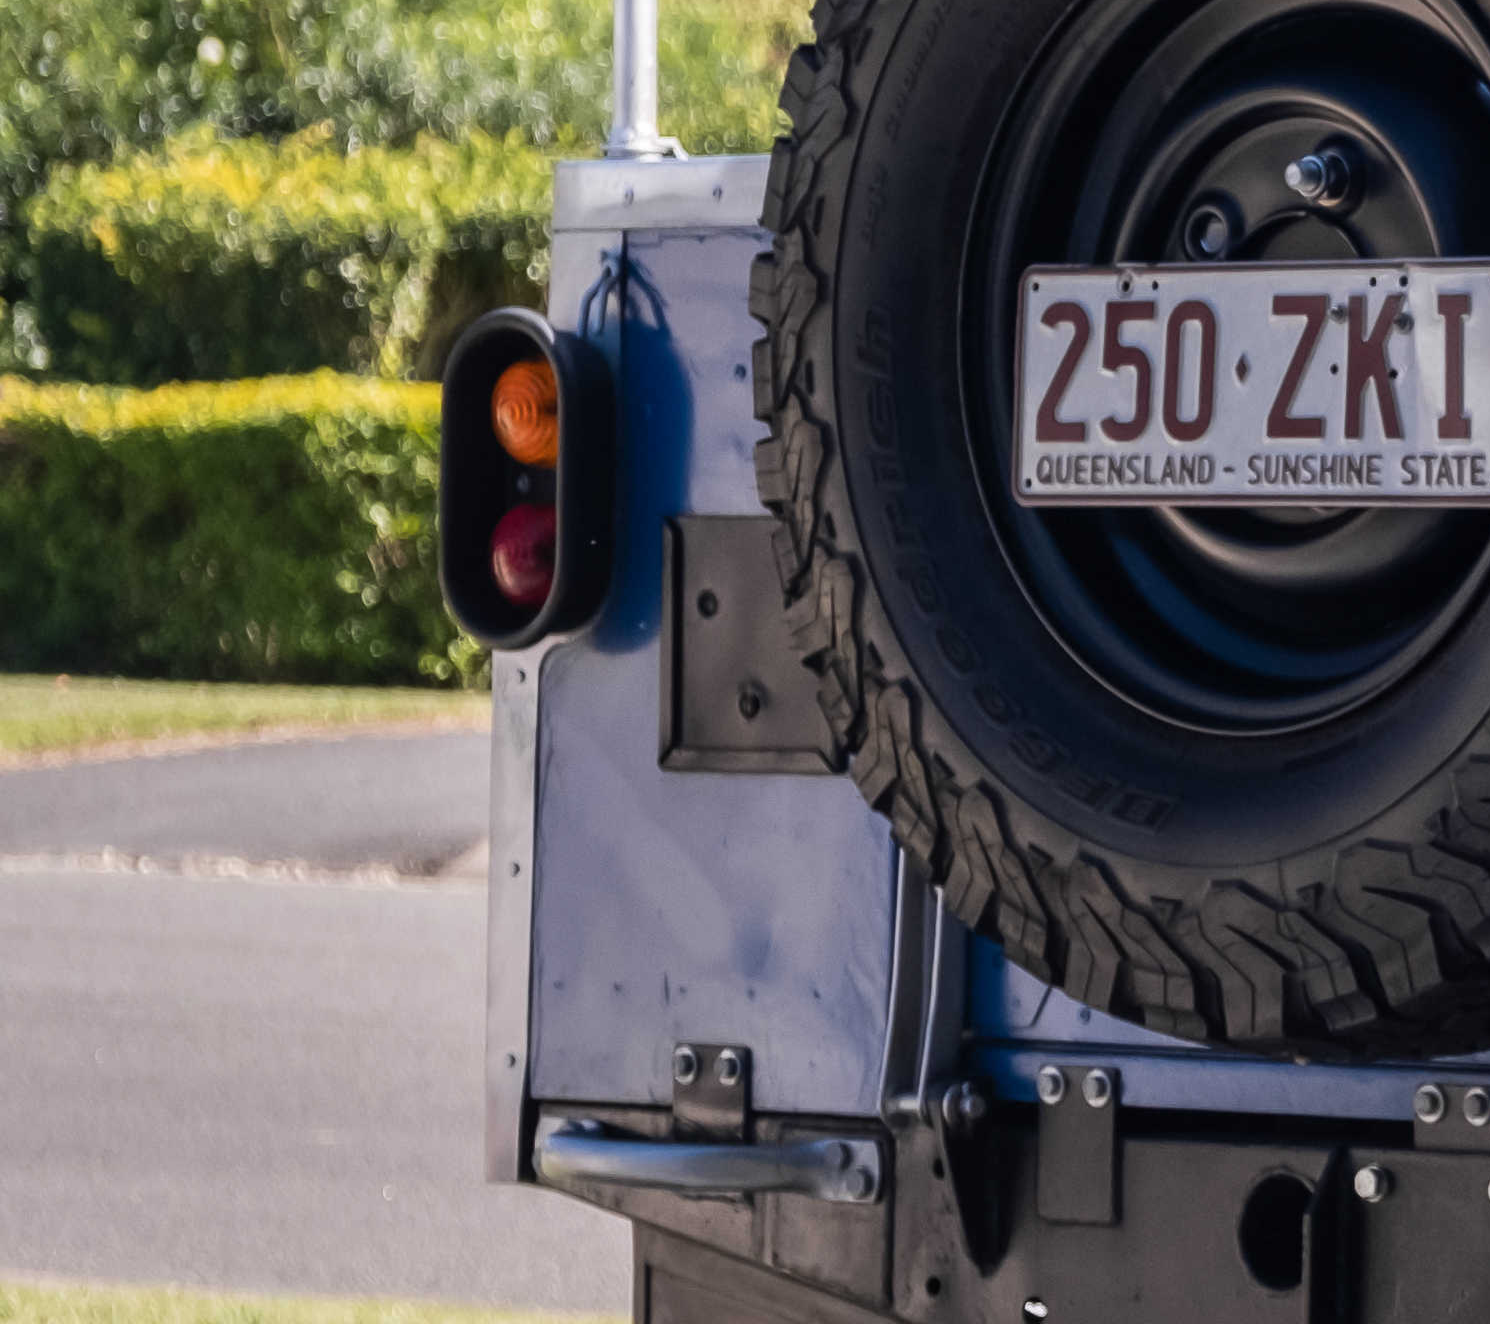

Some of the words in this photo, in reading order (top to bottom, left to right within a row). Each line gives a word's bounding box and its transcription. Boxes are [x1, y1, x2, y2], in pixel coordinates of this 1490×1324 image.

[1035, 300, 1218, 443] 250
[1266, 293, 1473, 440] ZKI
[1036, 453, 1216, 487] QUEENSLAND
[1247, 453, 1383, 488] SUNSHINE
[1401, 453, 1487, 488] STATE
